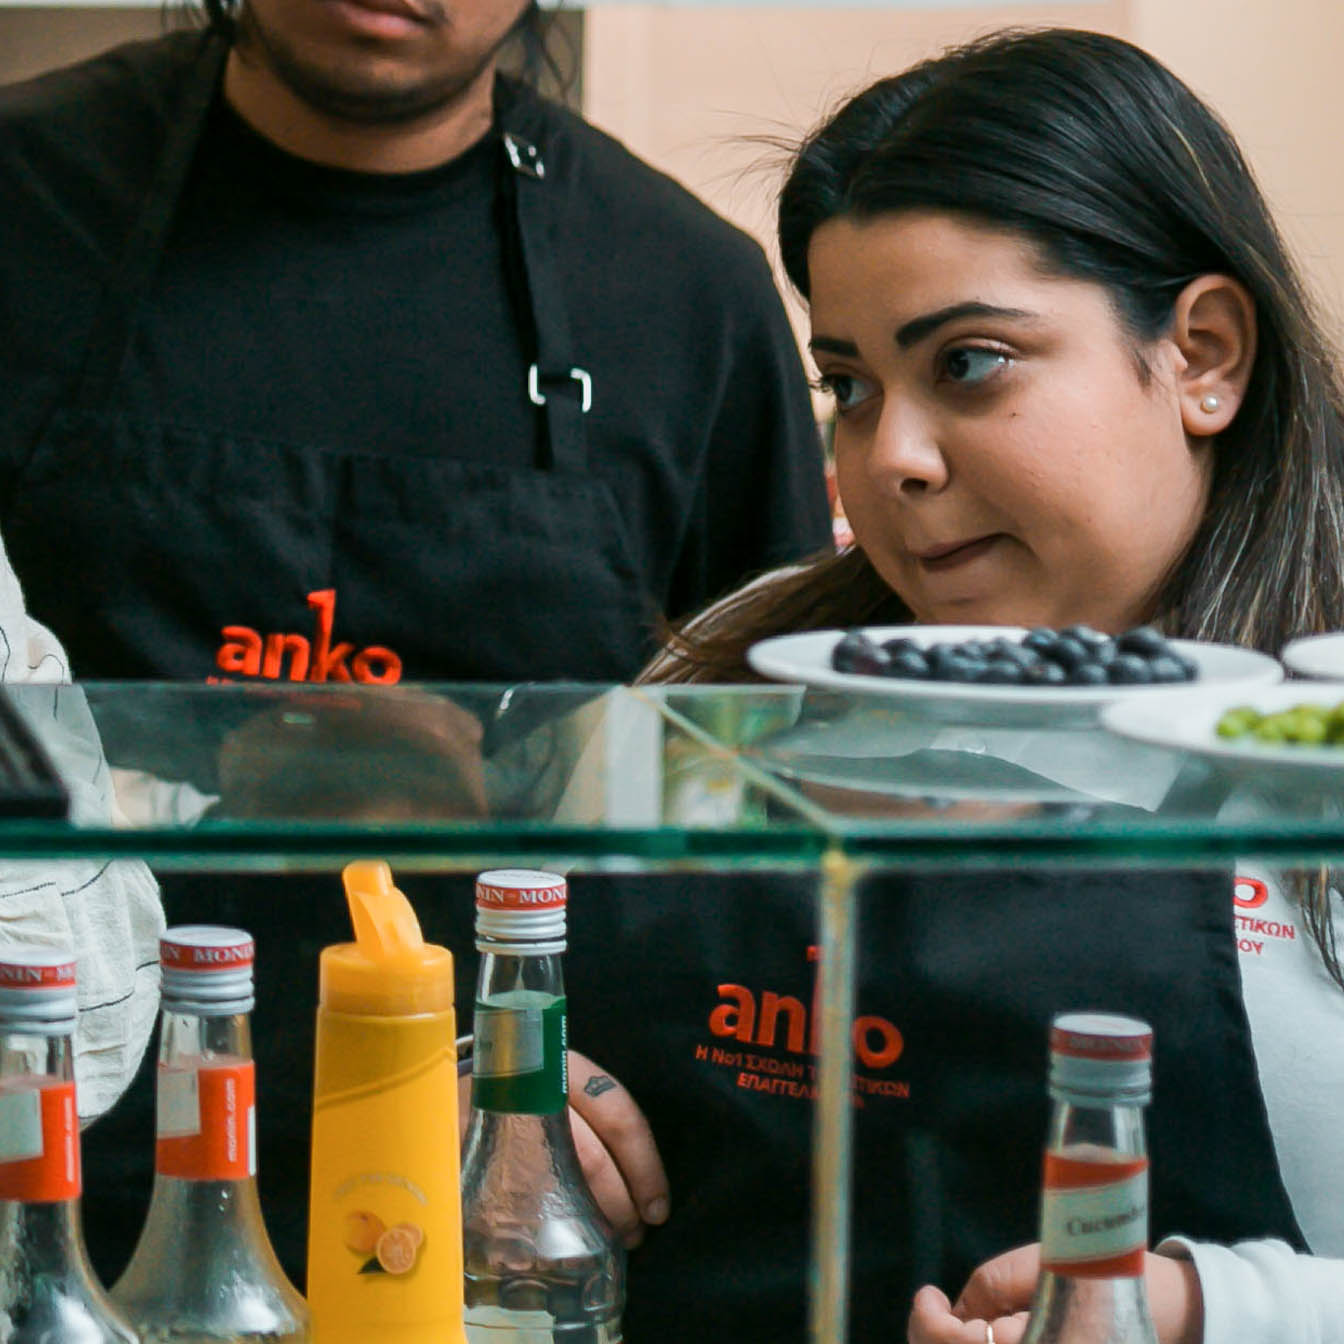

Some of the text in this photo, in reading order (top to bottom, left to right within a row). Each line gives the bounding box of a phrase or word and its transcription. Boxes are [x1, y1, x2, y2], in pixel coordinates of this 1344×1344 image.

[216, 589, 403, 686] anko
[476, 885, 567, 904] NIN MONI
[707, 945, 905, 1070] ano
[805, 1064, 911, 1100] ΤΤΙΚΩΝ
